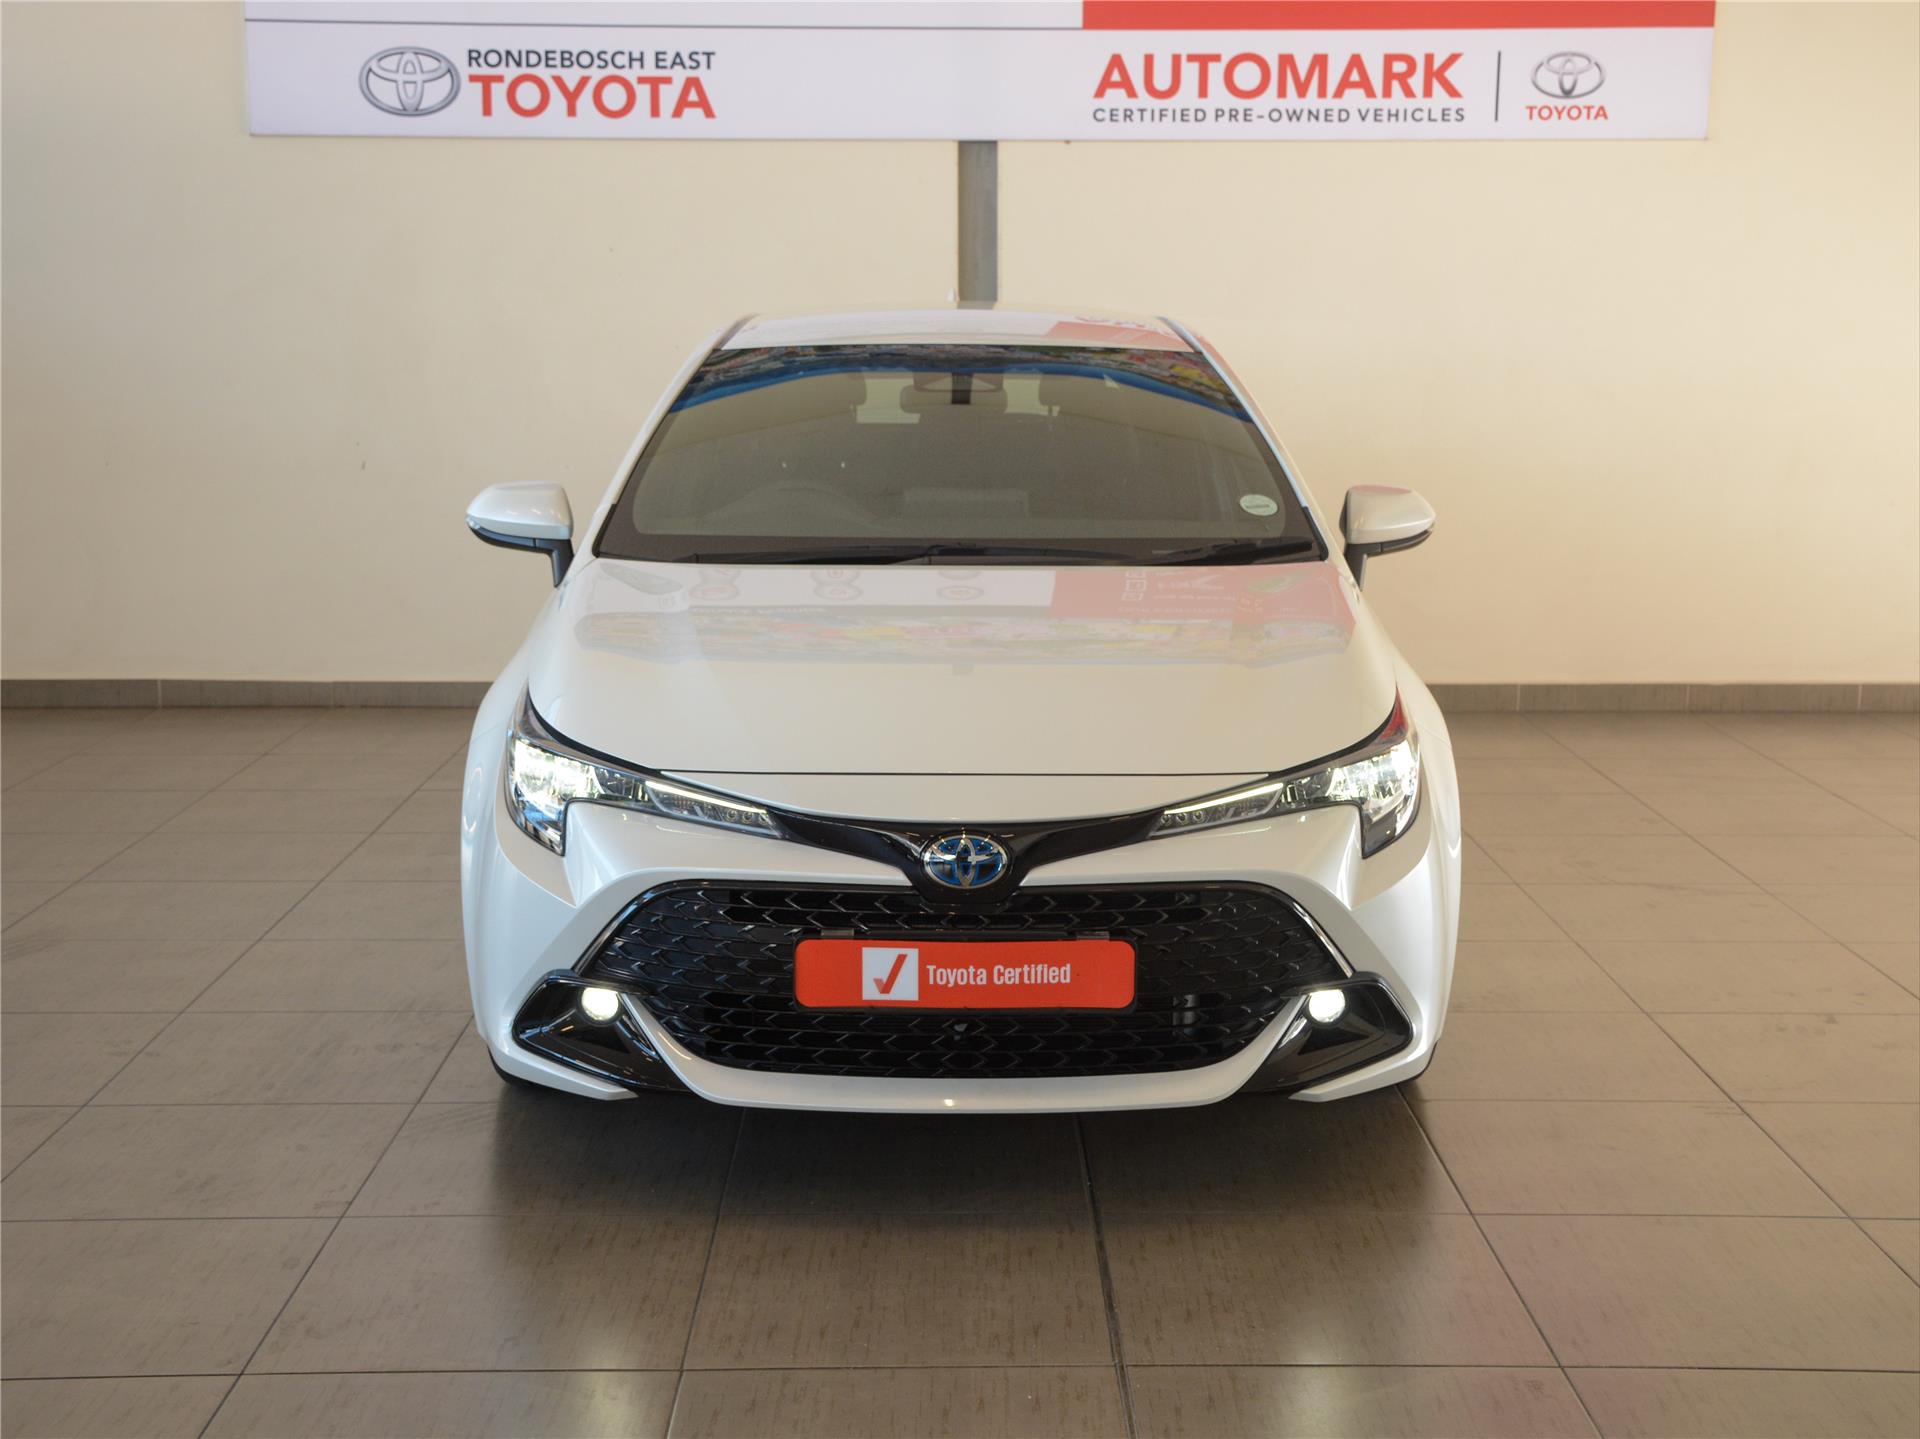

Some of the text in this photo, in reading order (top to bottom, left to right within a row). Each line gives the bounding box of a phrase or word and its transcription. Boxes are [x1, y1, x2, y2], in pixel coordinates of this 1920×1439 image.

[468, 49, 716, 71] RONDEBOSCH EAST
[1092, 52, 1464, 100] AUTOMARK
[468, 73, 716, 119] TOYOTA
[1093, 107, 1465, 123] CERTIFIED PRE-OWNED VEHICLES
[1526, 105, 1609, 122] TOYOTA
[926, 963, 1071, 988] Toyota Certified
